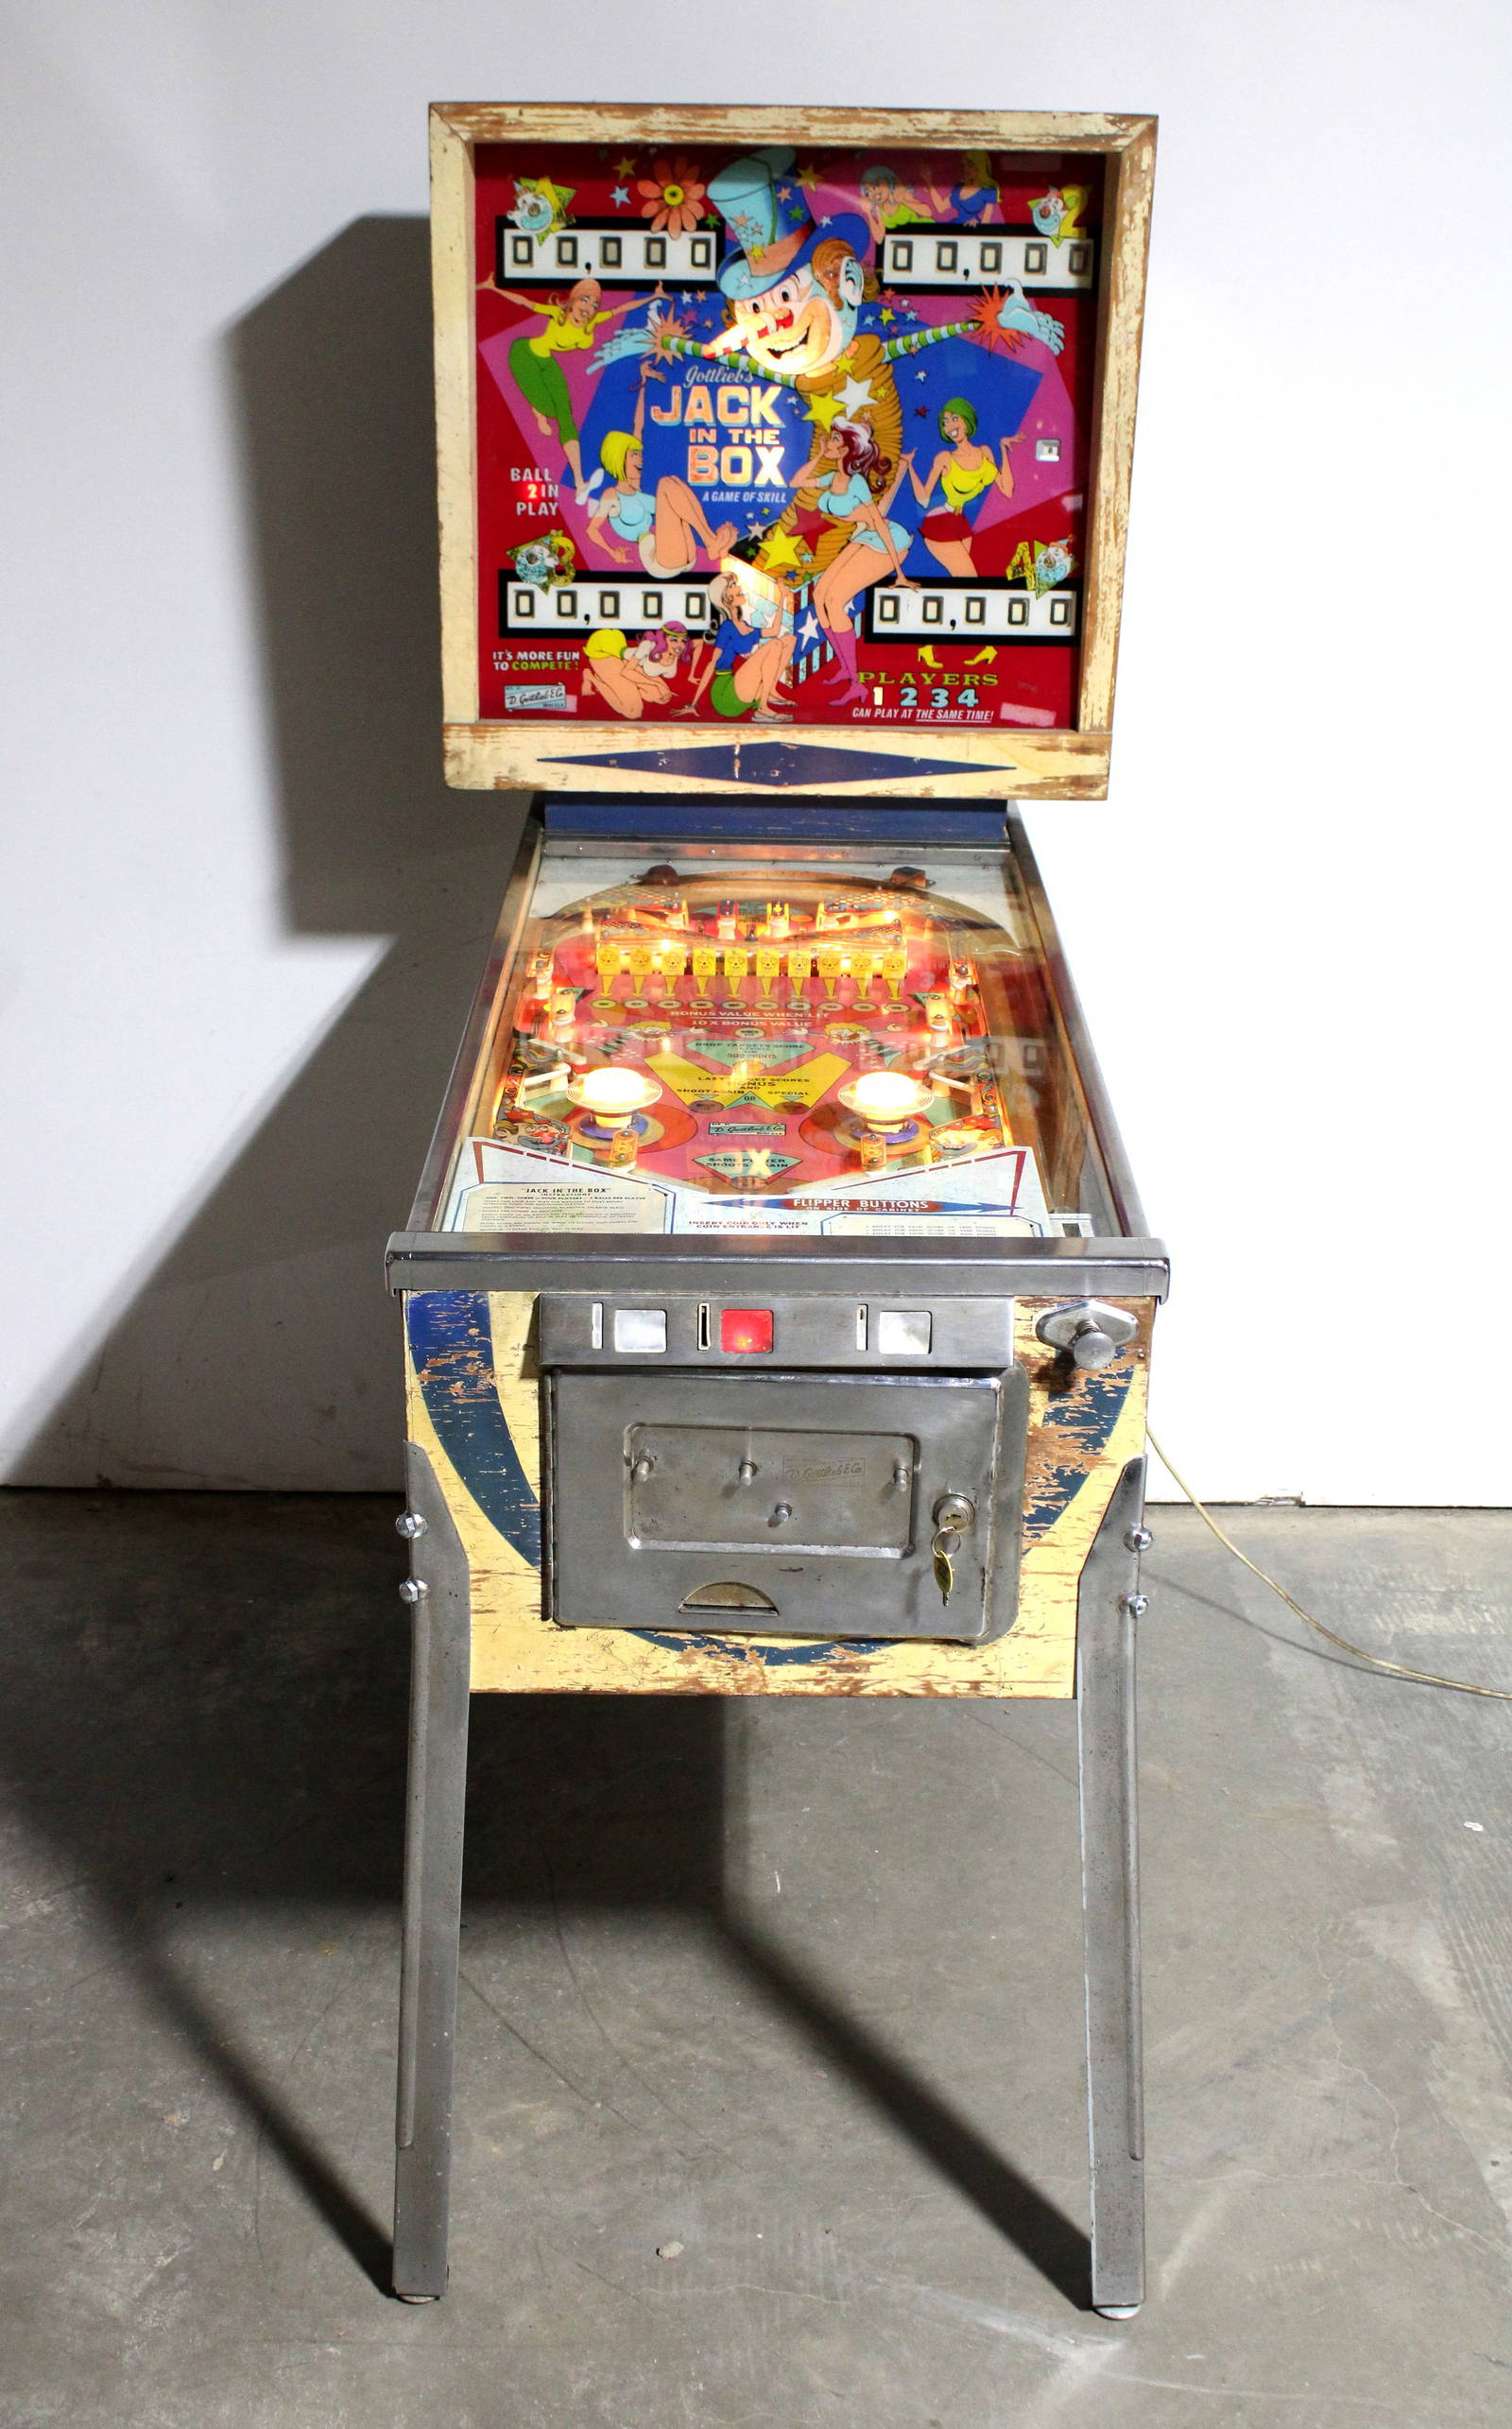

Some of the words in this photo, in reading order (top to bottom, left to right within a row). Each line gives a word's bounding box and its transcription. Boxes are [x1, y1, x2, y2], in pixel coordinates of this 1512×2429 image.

[1058, 183, 1088, 238] 2
[650, 385, 786, 428] JACK
[689, 427, 717, 443] IN
[728, 428, 781, 445] THE
[687, 444, 788, 488] BOX
[509, 467, 553, 482] BALL
[527, 483, 538, 499] 2
[541, 483, 559, 498] IN
[702, 491, 710, 503] A
[711, 491, 741, 503] GAME
[743, 491, 756, 503] OF
[757, 491, 787, 504] SKILL
[516, 501, 559, 517] PLAY
[1005, 541, 1038, 592] 4
[492, 648, 514, 661] IT'S
[516, 650, 554, 661] MORE
[556, 650, 580, 661] FUN
[493, 661, 509, 671] TO
[857, 671, 999, 687] PLAYERS
[872, 686, 885, 707] 1
[899, 686, 919, 707] 2
[930, 687, 950, 708] 3
[956, 688, 980, 708] 4
[851, 707, 871, 719] CAN
[873, 708, 900, 719] PLAY
[901, 709, 916, 719] AT
[916, 709, 936, 720] THE
[936, 710, 965, 721] SAME
[966, 711, 995, 722] TIME!
[793, 1198, 850, 1207] FLIPPER
[859, 1199, 929, 1209] BUTTONS
